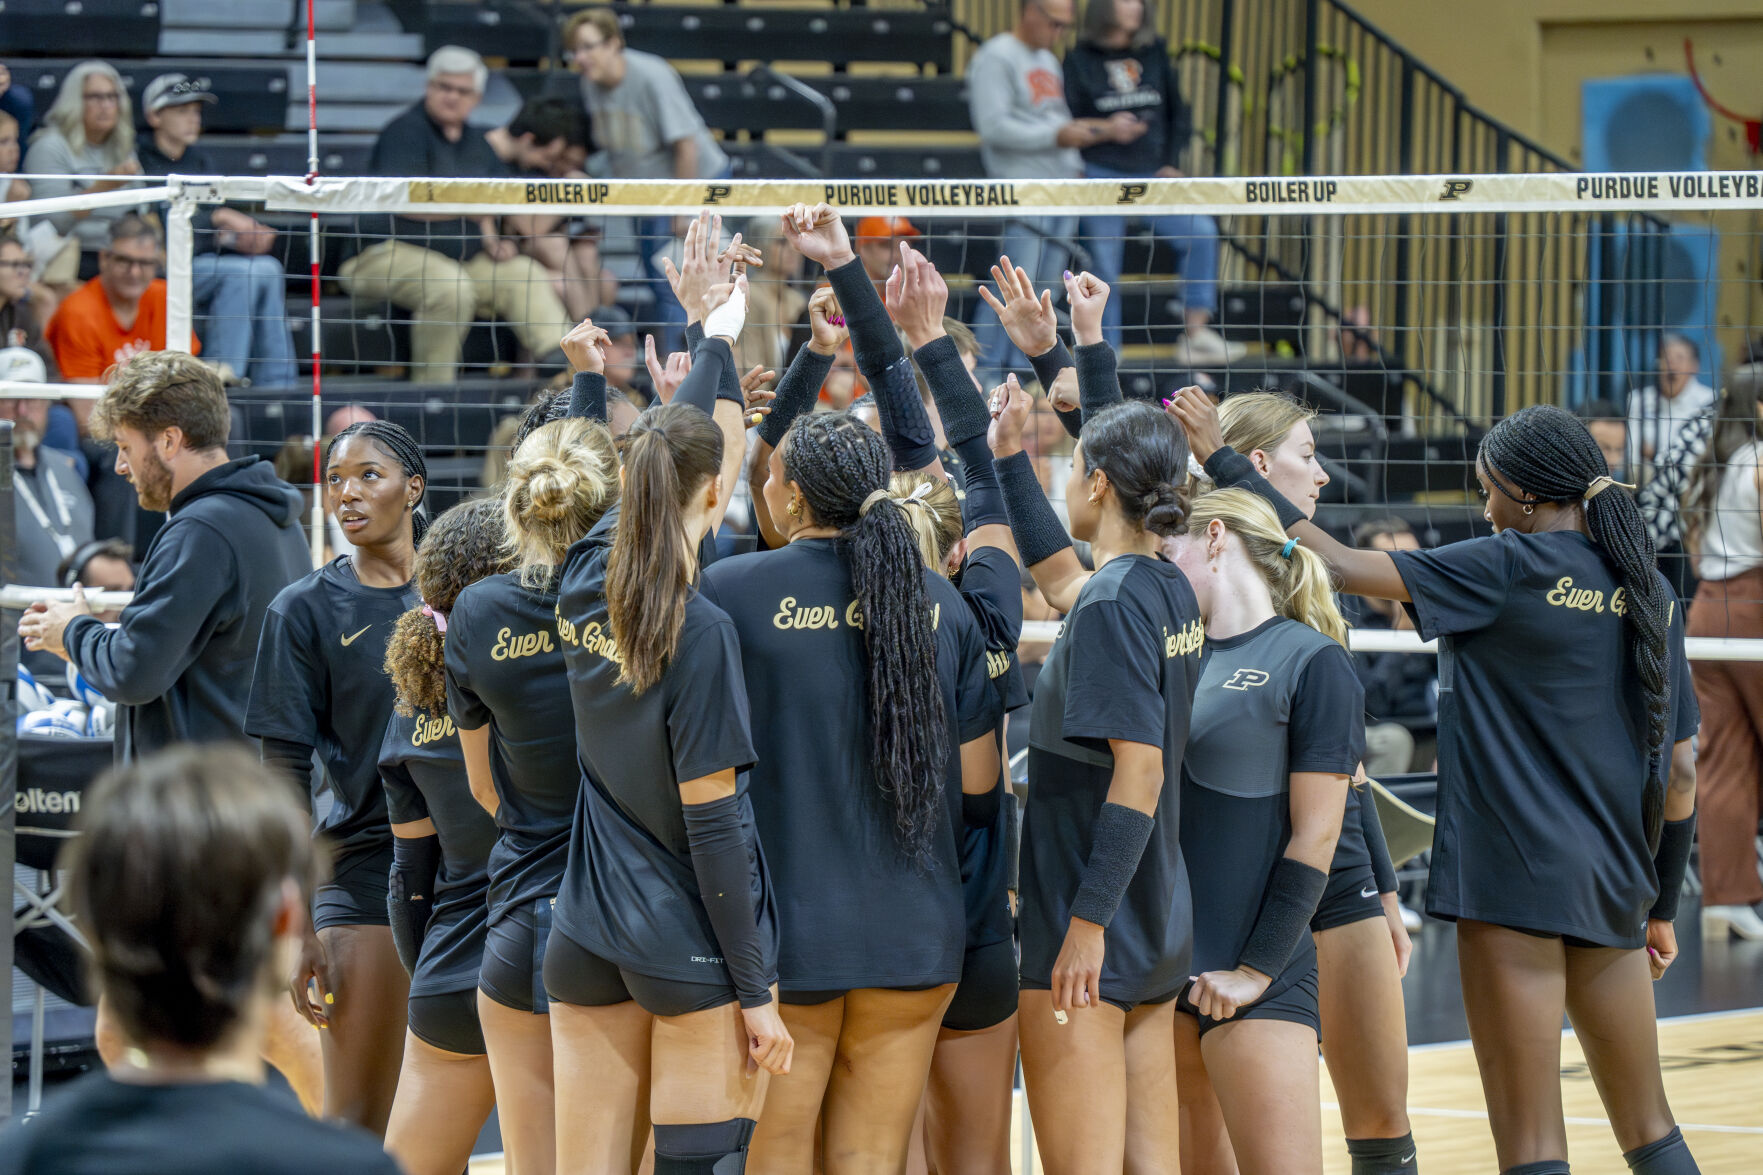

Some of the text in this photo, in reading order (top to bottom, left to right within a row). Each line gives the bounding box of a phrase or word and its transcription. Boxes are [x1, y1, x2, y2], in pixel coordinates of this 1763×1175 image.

[526, 183, 609, 204] BOILER UP
[703, 184, 732, 205] P
[824, 183, 1019, 206] PURDUE VOLLEYBALL
[1117, 182, 1149, 204] P
[1246, 181, 1337, 203] BOILER UP
[1439, 179, 1474, 201] P
[1576, 175, 1659, 199] PURDUE
[1546, 576, 1605, 614] Ever
[773, 596, 839, 630] Ever
[490, 626, 554, 662] Ever
[1222, 668, 1270, 691] P
[411, 713, 456, 747] Ever
[15, 787, 81, 814] olten
[690, 955, 724, 964] DRI-FIT
